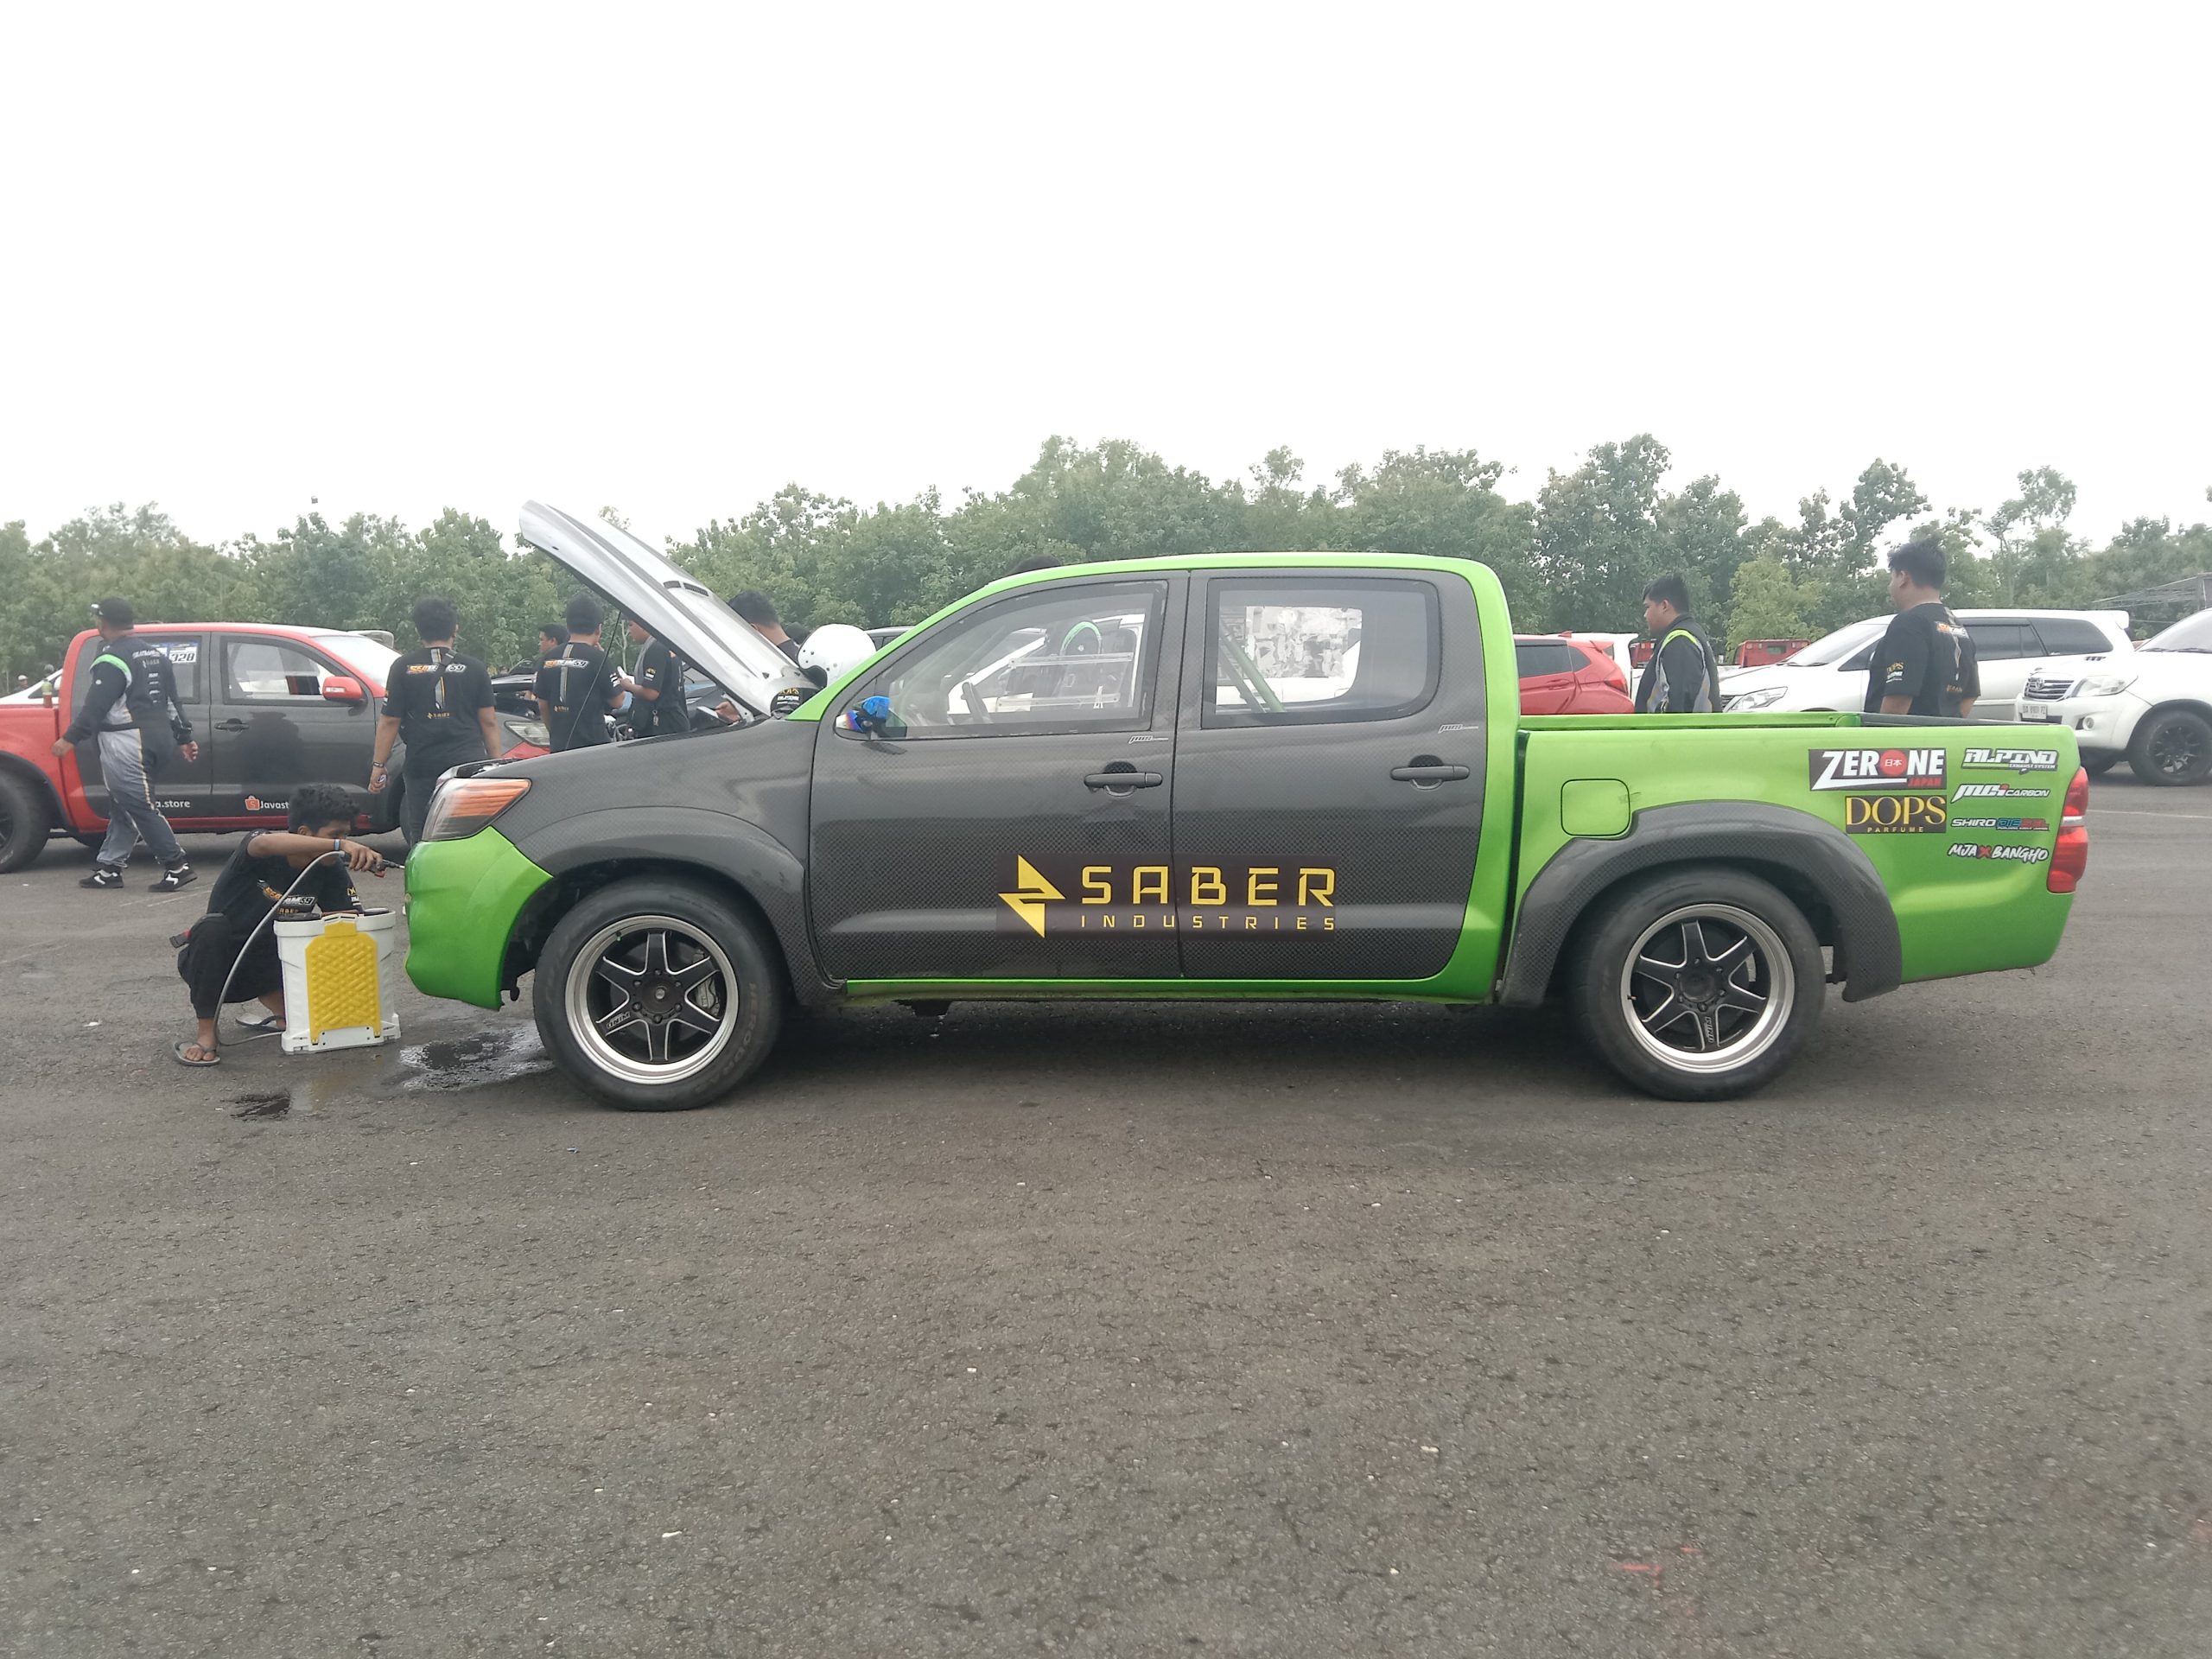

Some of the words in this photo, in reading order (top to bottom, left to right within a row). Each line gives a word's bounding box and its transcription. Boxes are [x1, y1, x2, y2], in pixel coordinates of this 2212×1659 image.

[1847, 797, 1946, 825] DOPS
[1952, 818, 1996, 827] SHIRO
[1948, 844, 1977, 856] MJA
[1991, 845, 2049, 863] BANGHO
[1082, 866, 1335, 906] SABER
[1081, 915, 1334, 931] INDUSTRIES
